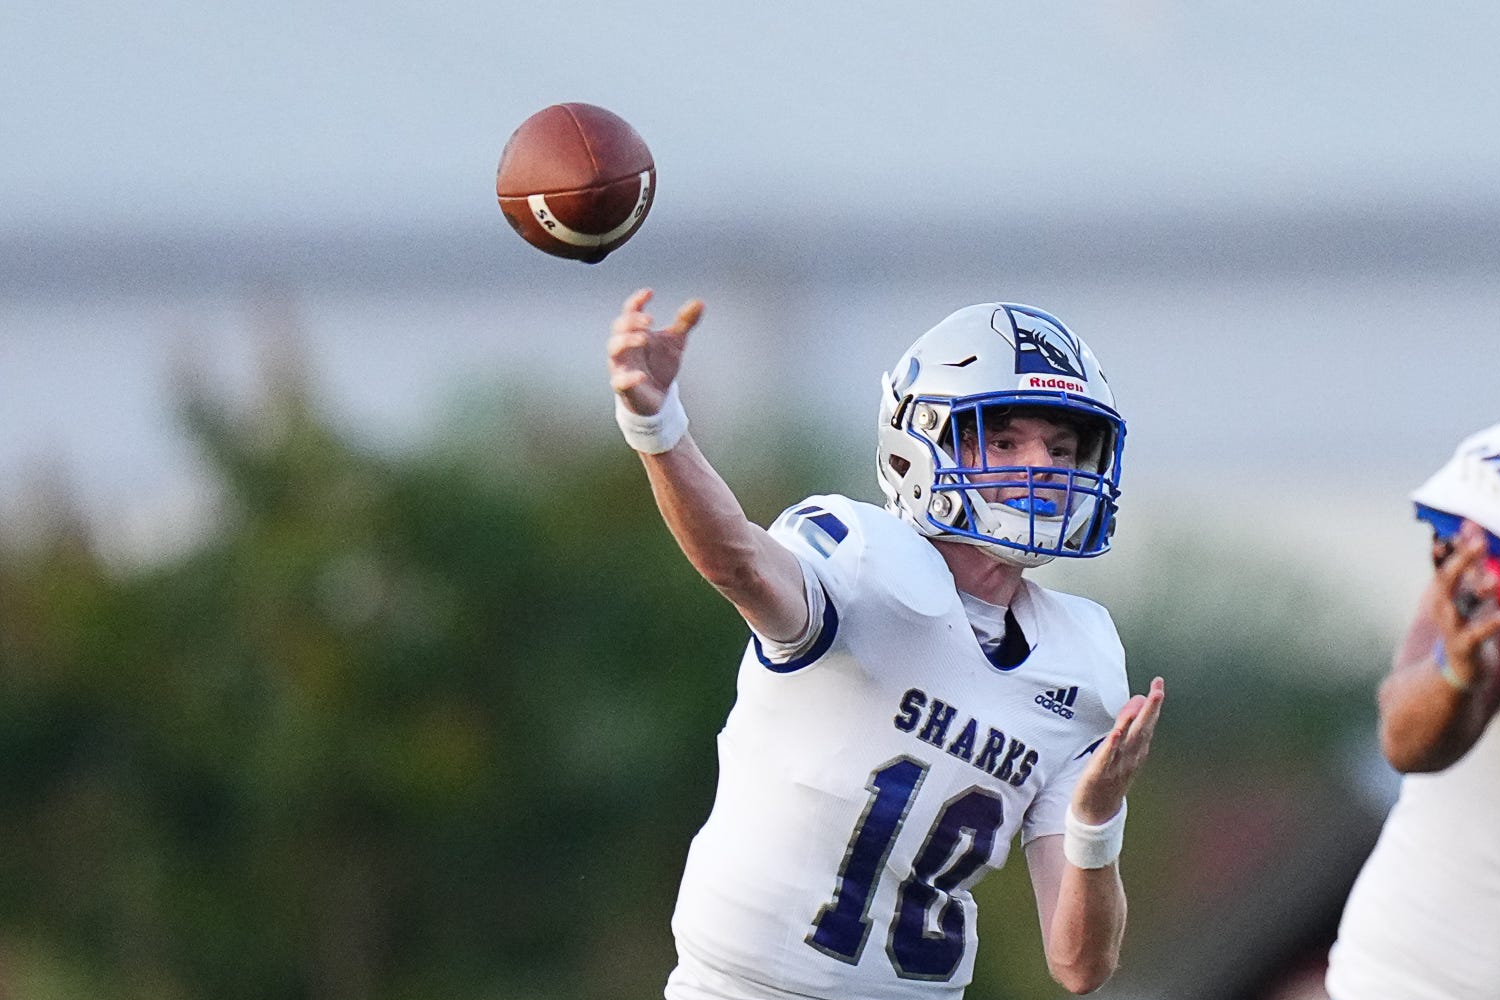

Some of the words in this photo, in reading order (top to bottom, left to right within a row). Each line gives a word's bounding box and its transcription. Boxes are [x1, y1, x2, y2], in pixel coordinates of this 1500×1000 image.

[1029, 377, 1084, 393] Riddell
[1034, 694, 1075, 720] adidas
[894, 687, 1039, 788] SHARKS
